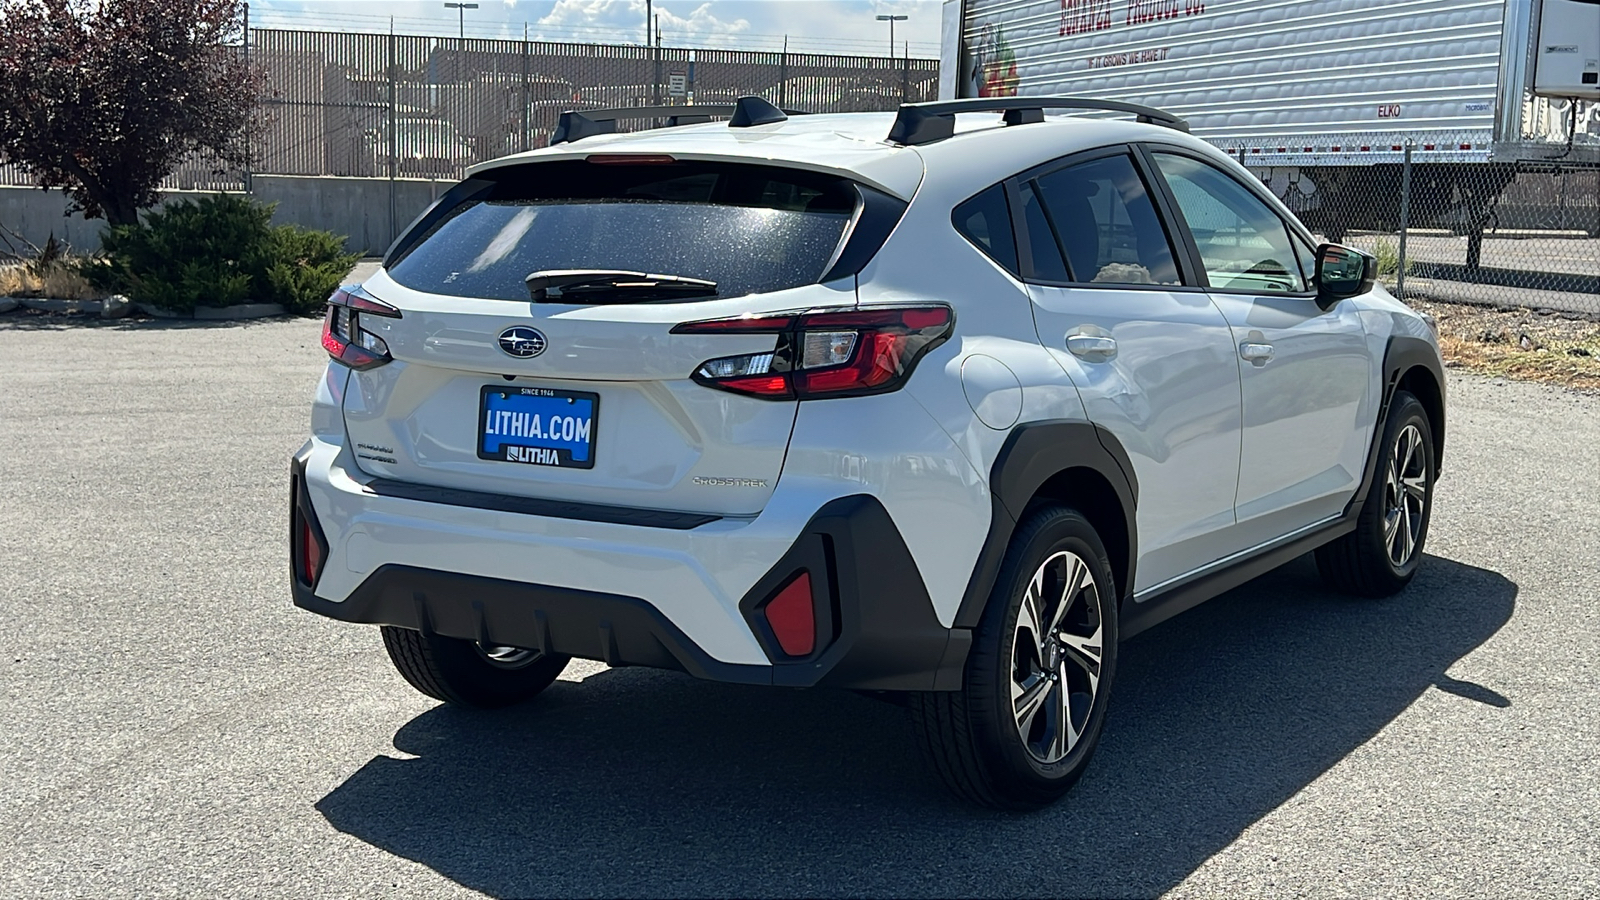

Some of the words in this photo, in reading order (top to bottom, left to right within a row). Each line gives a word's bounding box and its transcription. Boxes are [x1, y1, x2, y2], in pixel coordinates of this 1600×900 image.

[1141, 49, 1158, 62] HAVE
[1378, 104, 1401, 117] ELKO
[521, 388, 539, 396] SINCE
[485, 409, 592, 443] LITHIA.COM
[518, 446, 559, 465] LITHIA
[692, 476, 768, 488] CROSSTREK
